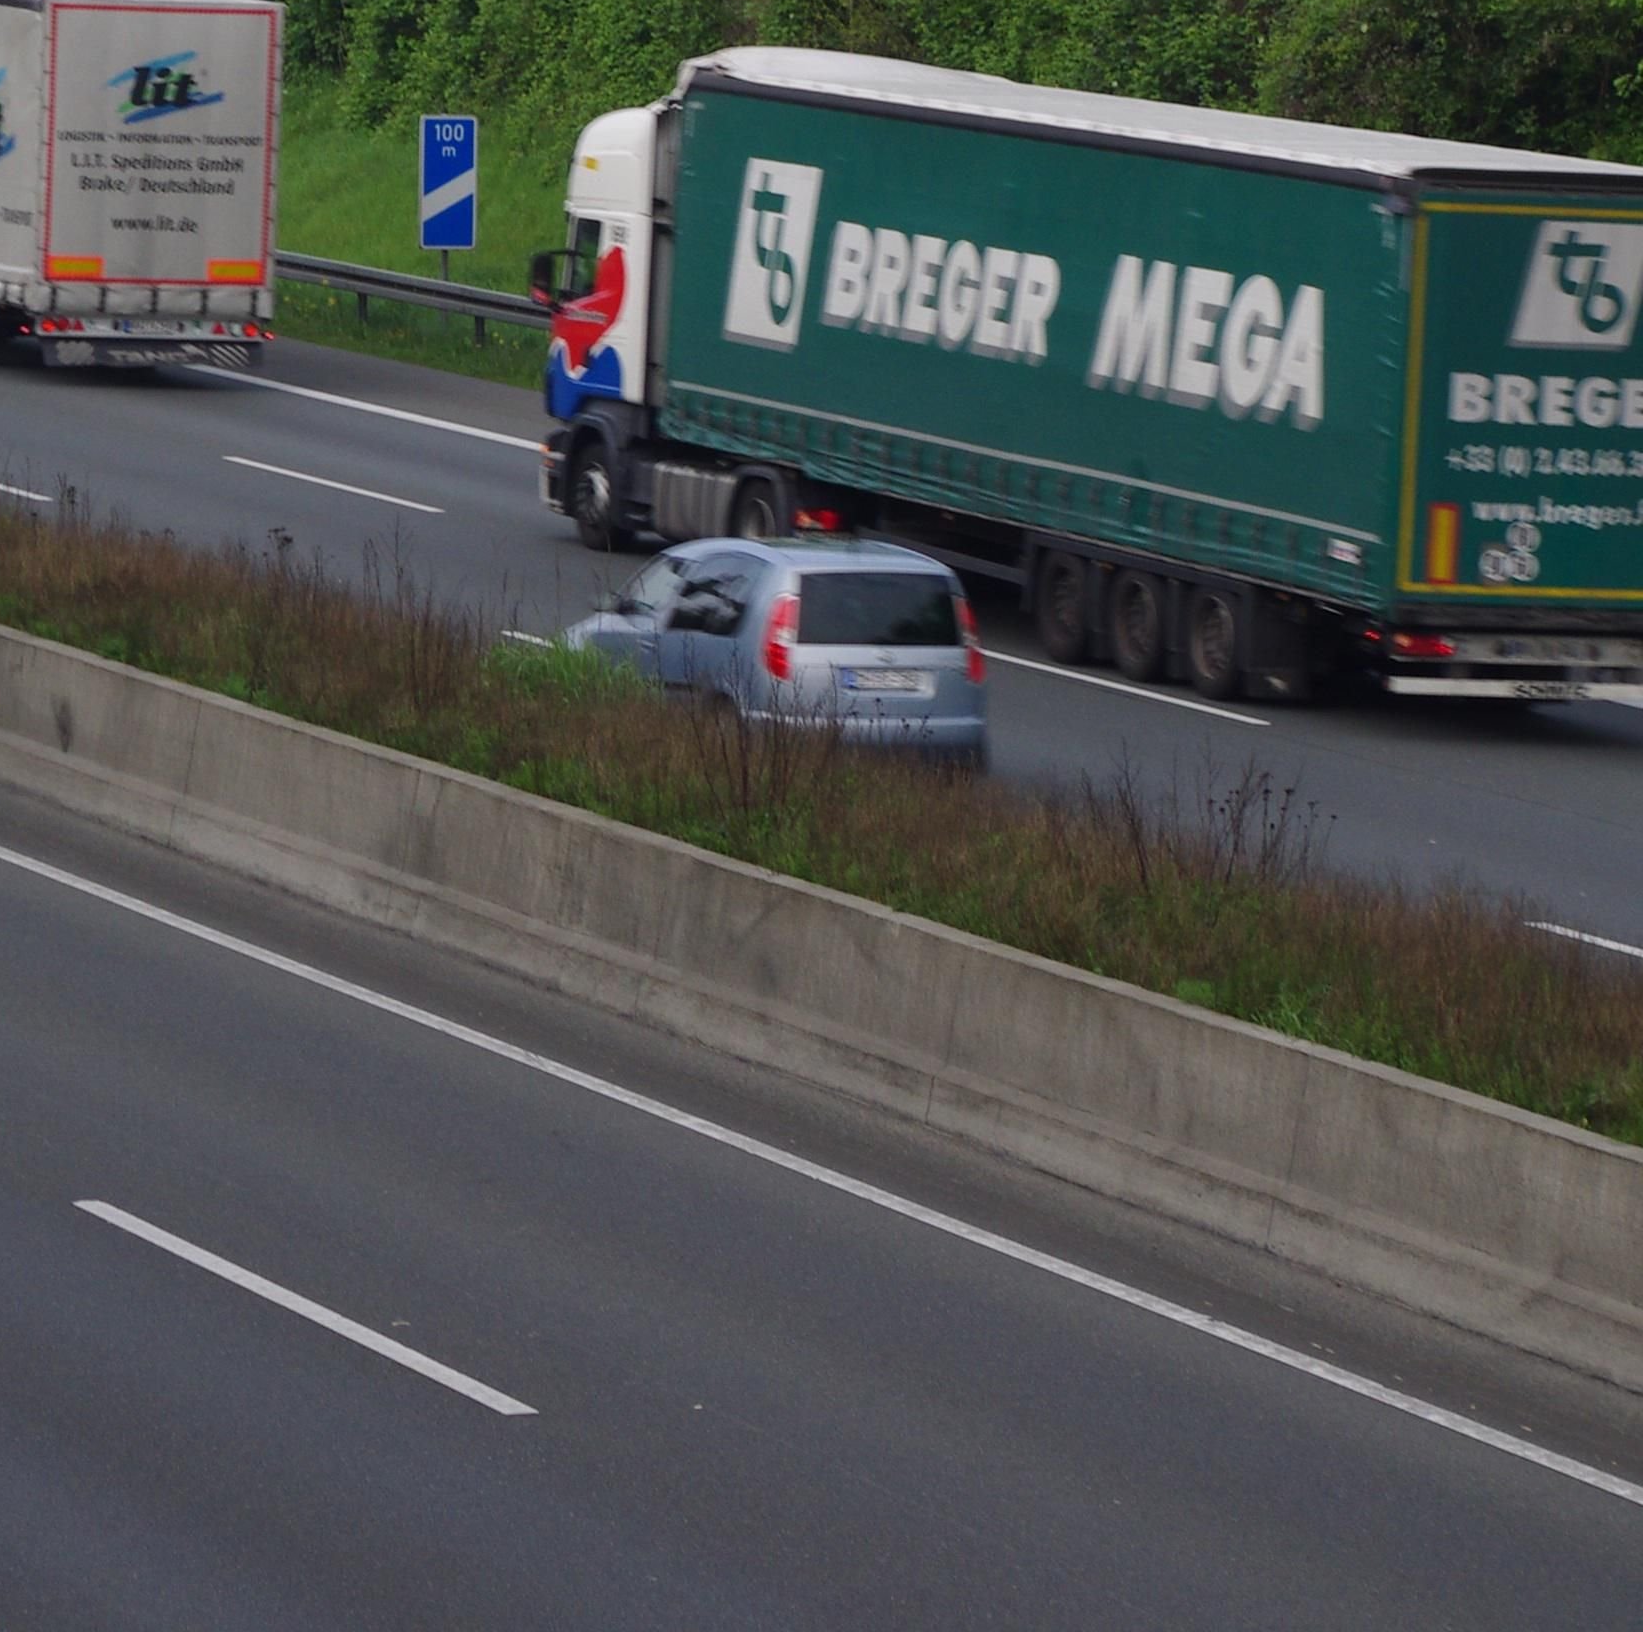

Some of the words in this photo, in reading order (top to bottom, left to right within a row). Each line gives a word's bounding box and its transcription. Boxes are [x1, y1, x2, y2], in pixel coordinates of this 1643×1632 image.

[131, 66, 199, 108] lit
[434, 123, 465, 142] 100
[442, 145, 456, 157] m
[820, 220, 1061, 366] BREGER
[1085, 253, 1325, 432] MEGA
[1446, 371, 1643, 429] BREGE
